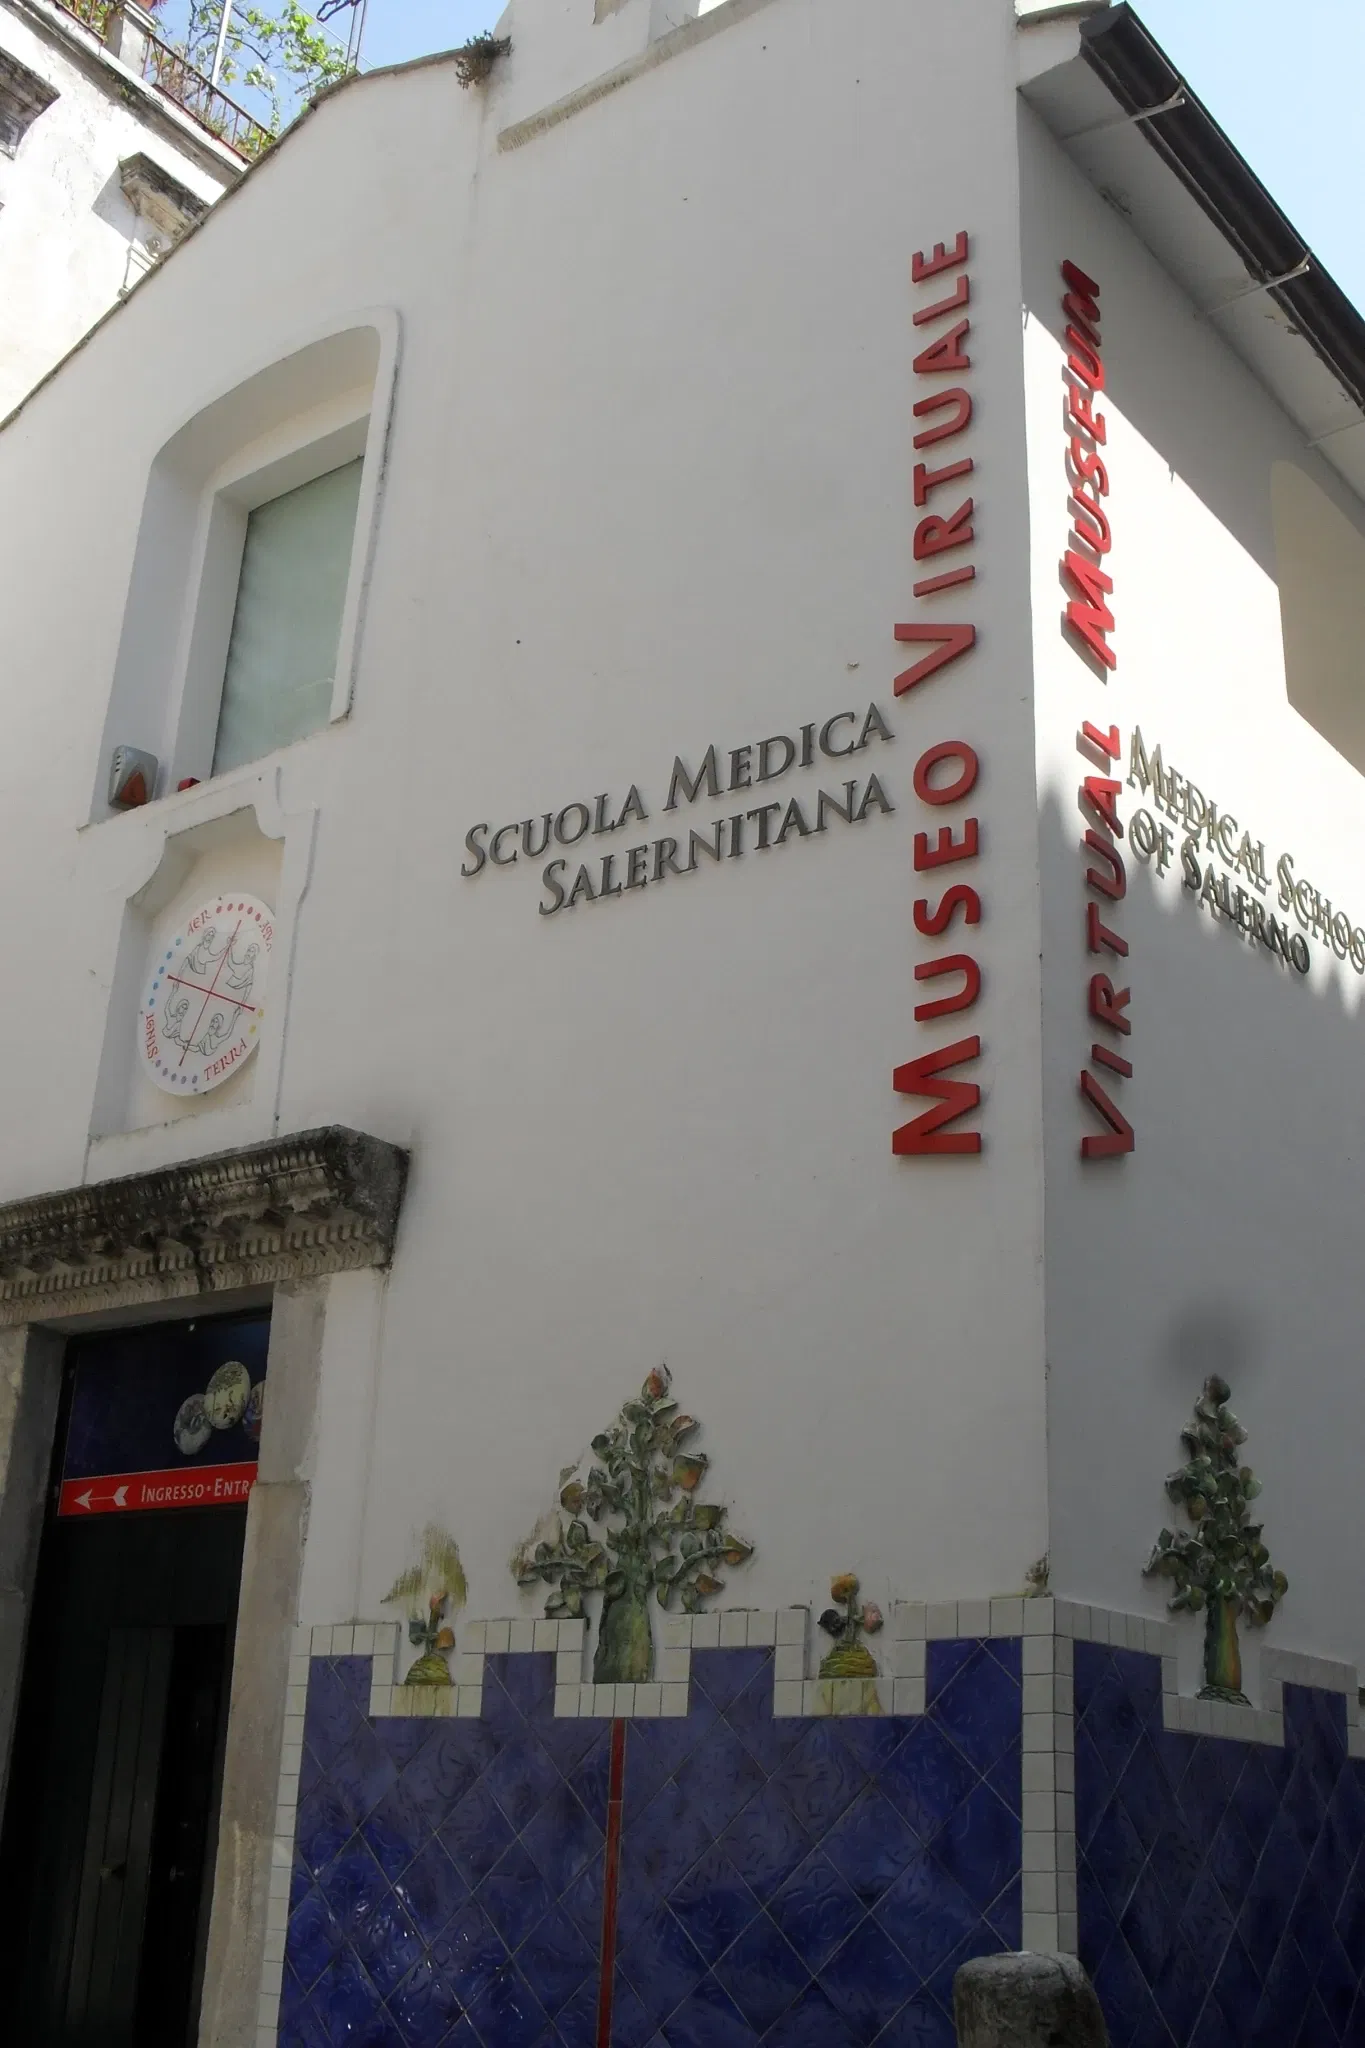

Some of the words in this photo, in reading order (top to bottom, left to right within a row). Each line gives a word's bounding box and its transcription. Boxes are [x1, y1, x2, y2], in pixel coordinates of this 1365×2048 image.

[894, 230, 975, 697] VIRTUALE
[1062, 260, 1117, 671] MUSEUM
[461, 784, 648, 876] SCUOLA
[663, 702, 895, 811] MEDICA
[539, 773, 895, 915] SALERNITANA
[1127, 725, 1272, 893] MEDICAL
[893, 741, 981, 1155] MUSEO
[1080, 720, 1134, 1158] VIRTUAL
[1129, 808, 1174, 877] OF
[1181, 834, 1310, 974] SALERNO
[203, 1037, 247, 1081] TERRA
[141, 1484, 204, 1502] INGRESSO
